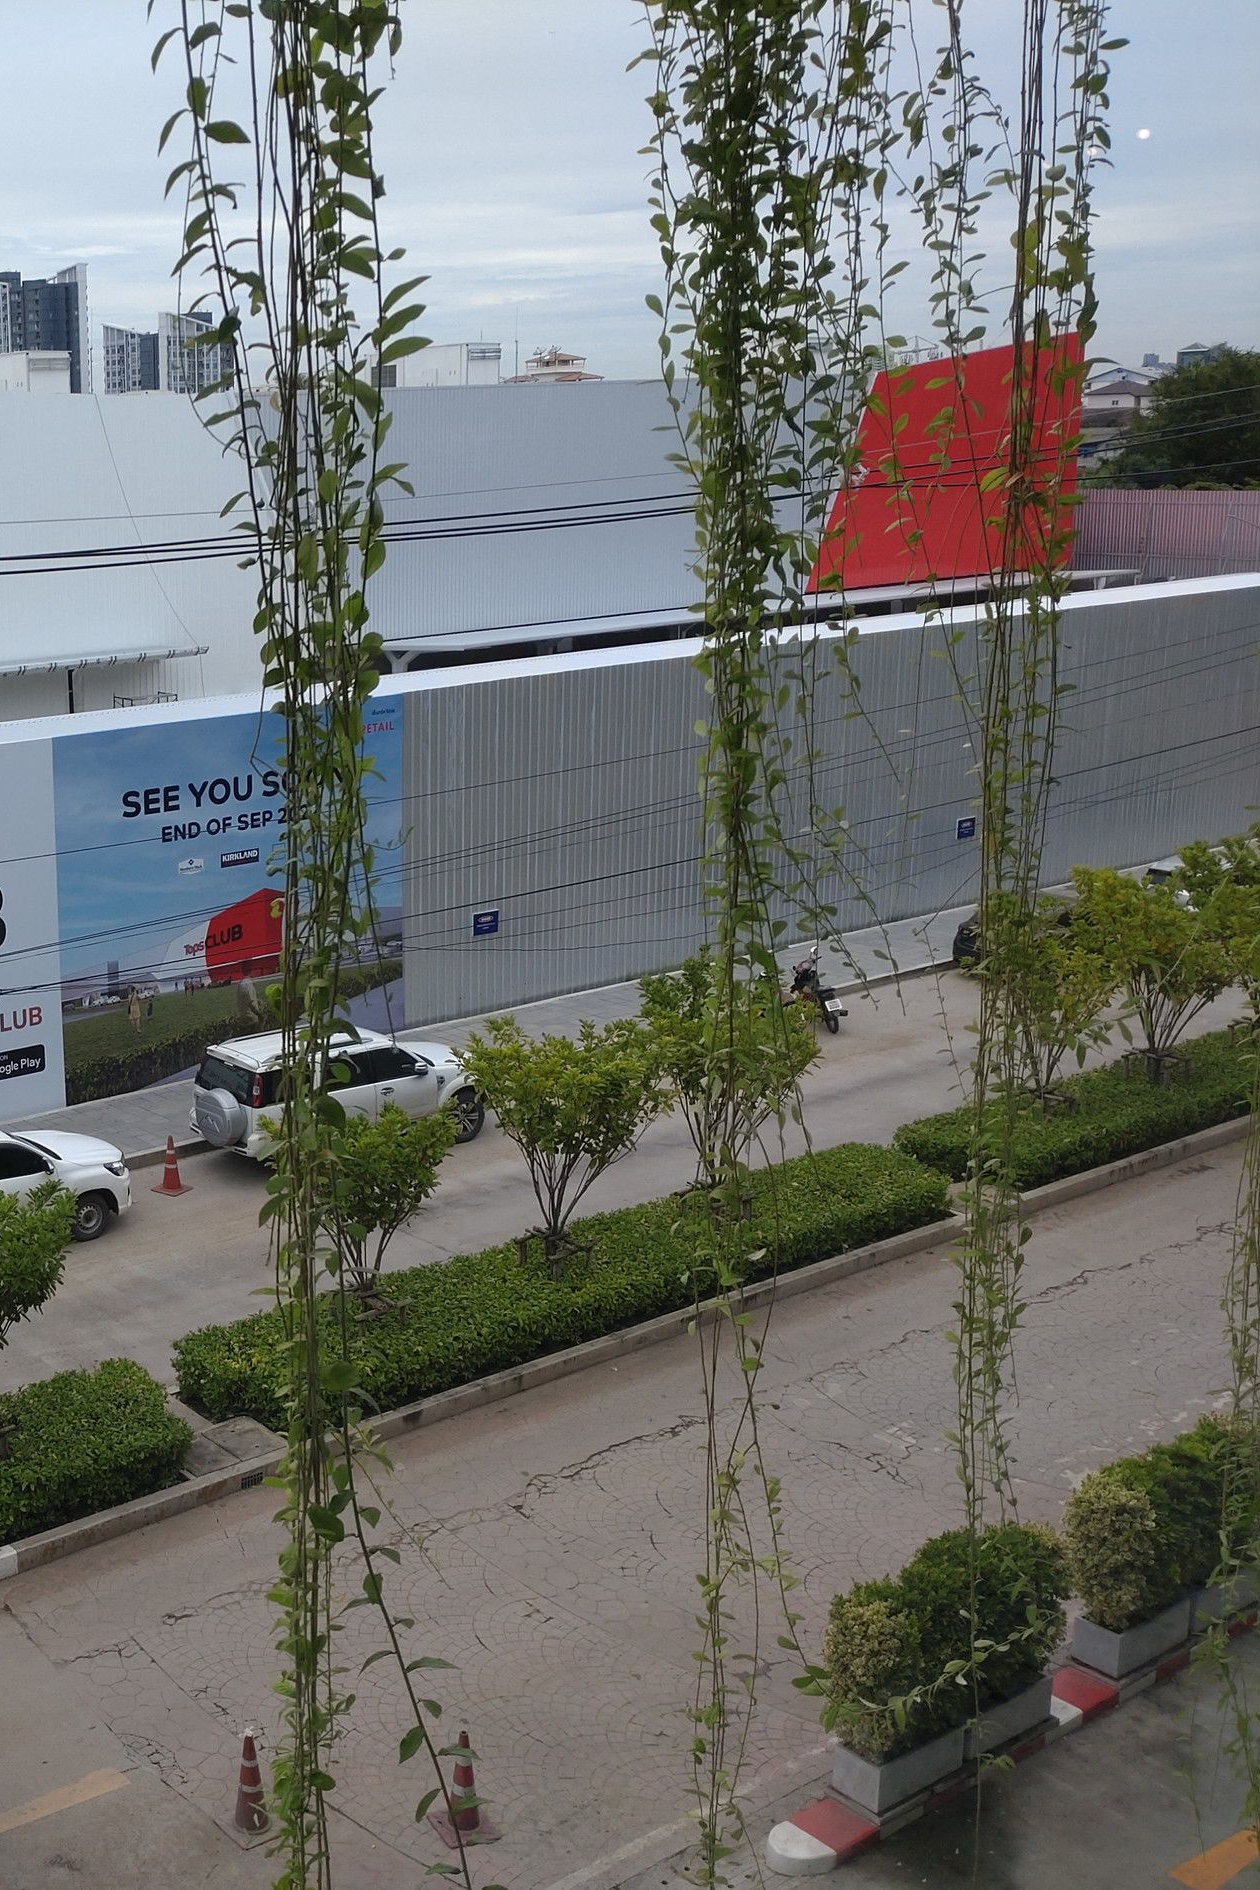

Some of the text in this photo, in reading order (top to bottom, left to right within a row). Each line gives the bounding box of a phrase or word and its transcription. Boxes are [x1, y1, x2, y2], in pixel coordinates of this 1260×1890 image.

[122, 784, 180, 818] SEE
[188, 774, 252, 807] YOU
[161, 821, 201, 843] END
[206, 816, 233, 836] OF
[237, 810, 273, 831] SEP
[222, 850, 258, 862] KIRKLAND
[205, 924, 244, 949] CLUB
[20, 1057, 41, 1070] Play
